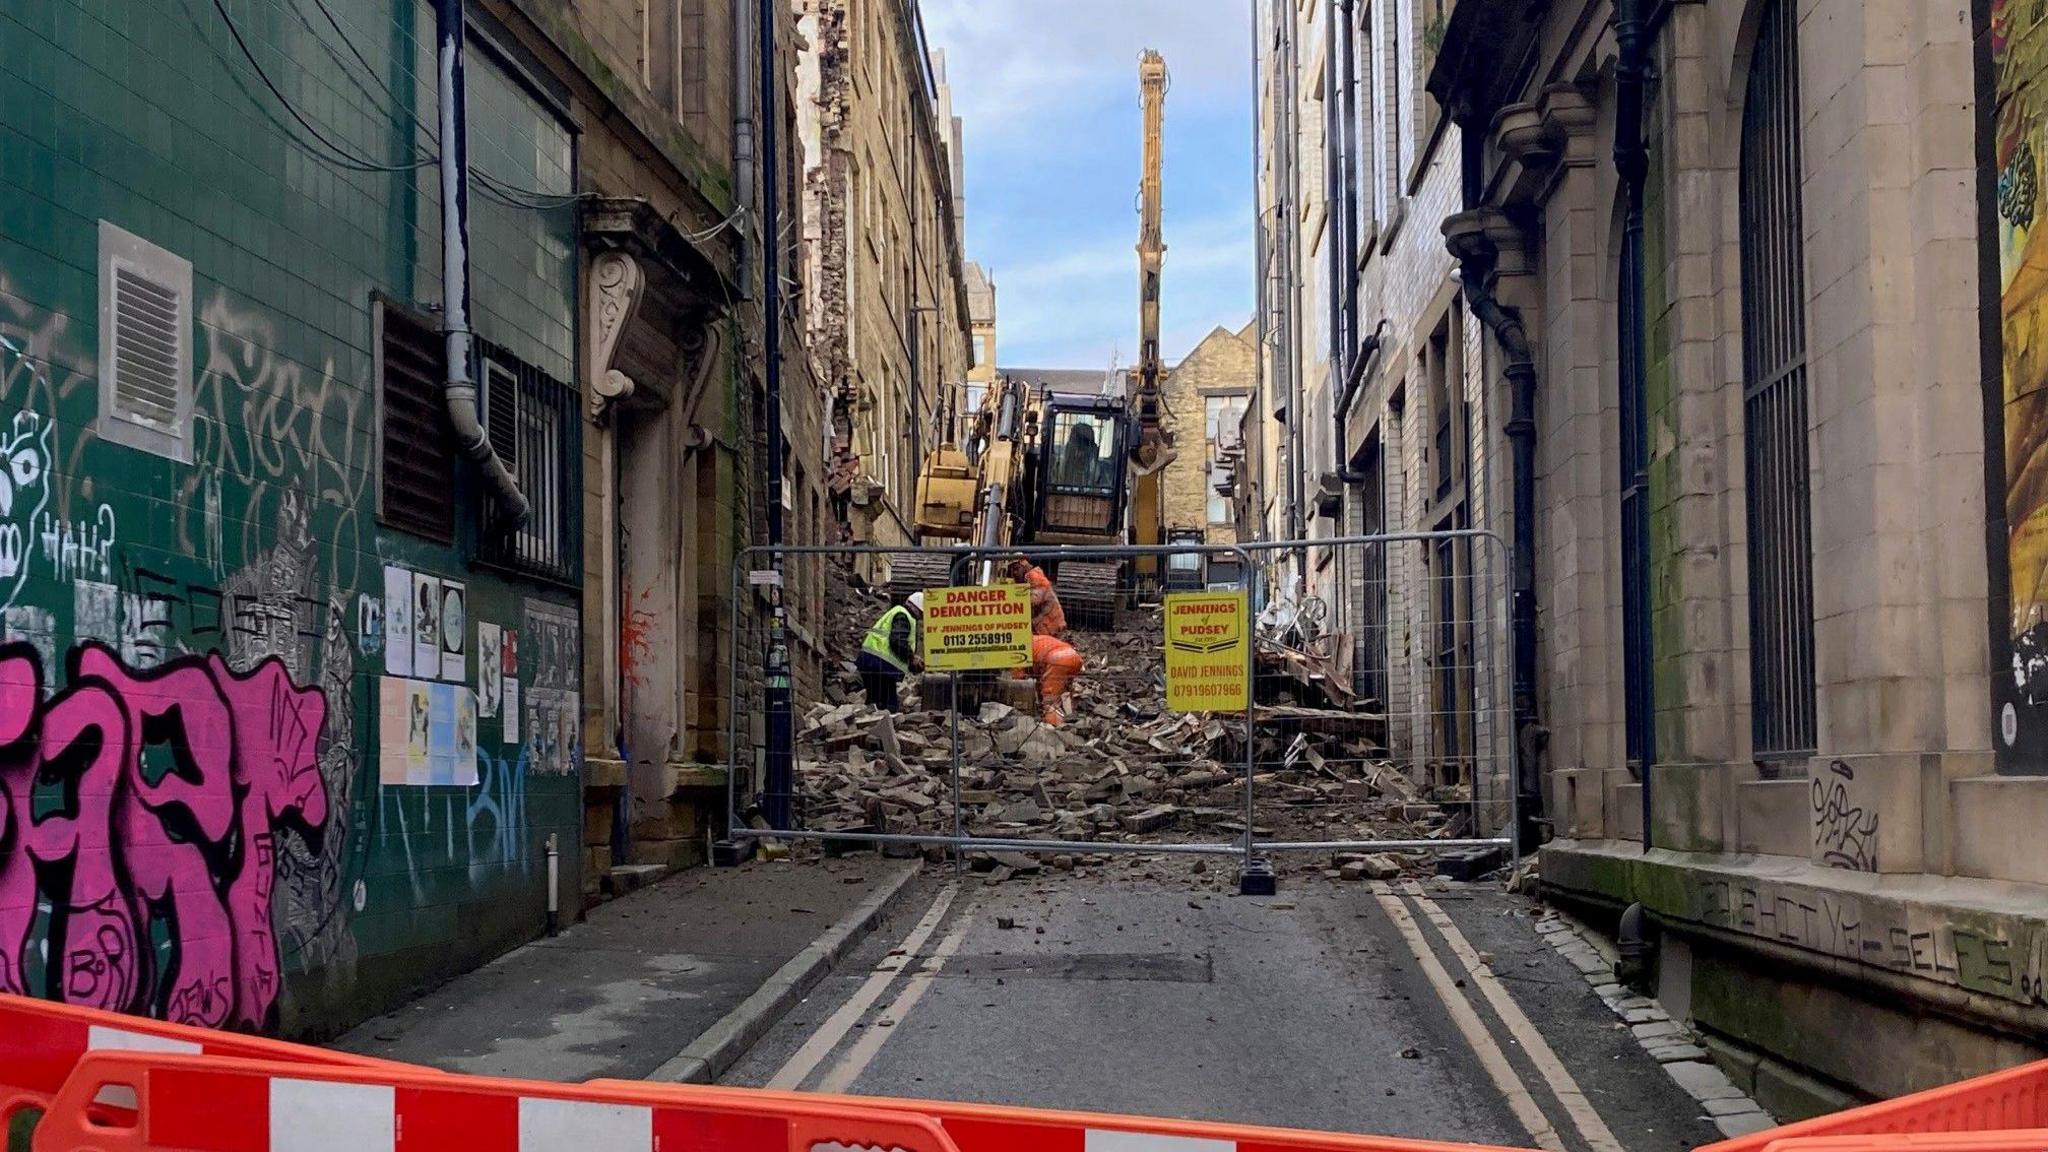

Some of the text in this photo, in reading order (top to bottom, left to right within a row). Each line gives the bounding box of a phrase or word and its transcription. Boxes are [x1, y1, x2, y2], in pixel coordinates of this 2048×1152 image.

[946, 589, 1006, 604] DANGER
[929, 603, 1024, 618] DEMOLITION
[1172, 603, 1236, 615] JENNINGS
[941, 623, 983, 633] JENNINGS
[984, 623, 994, 631] OF
[996, 622, 1029, 630] PUDSEY
[1180, 624, 1230, 635] PUDSEY
[943, 632, 1012, 647] 0113 2558919
[1170, 665, 1244, 679] DAVID JENNINGS
[1174, 684, 1242, 697] 07919607966
